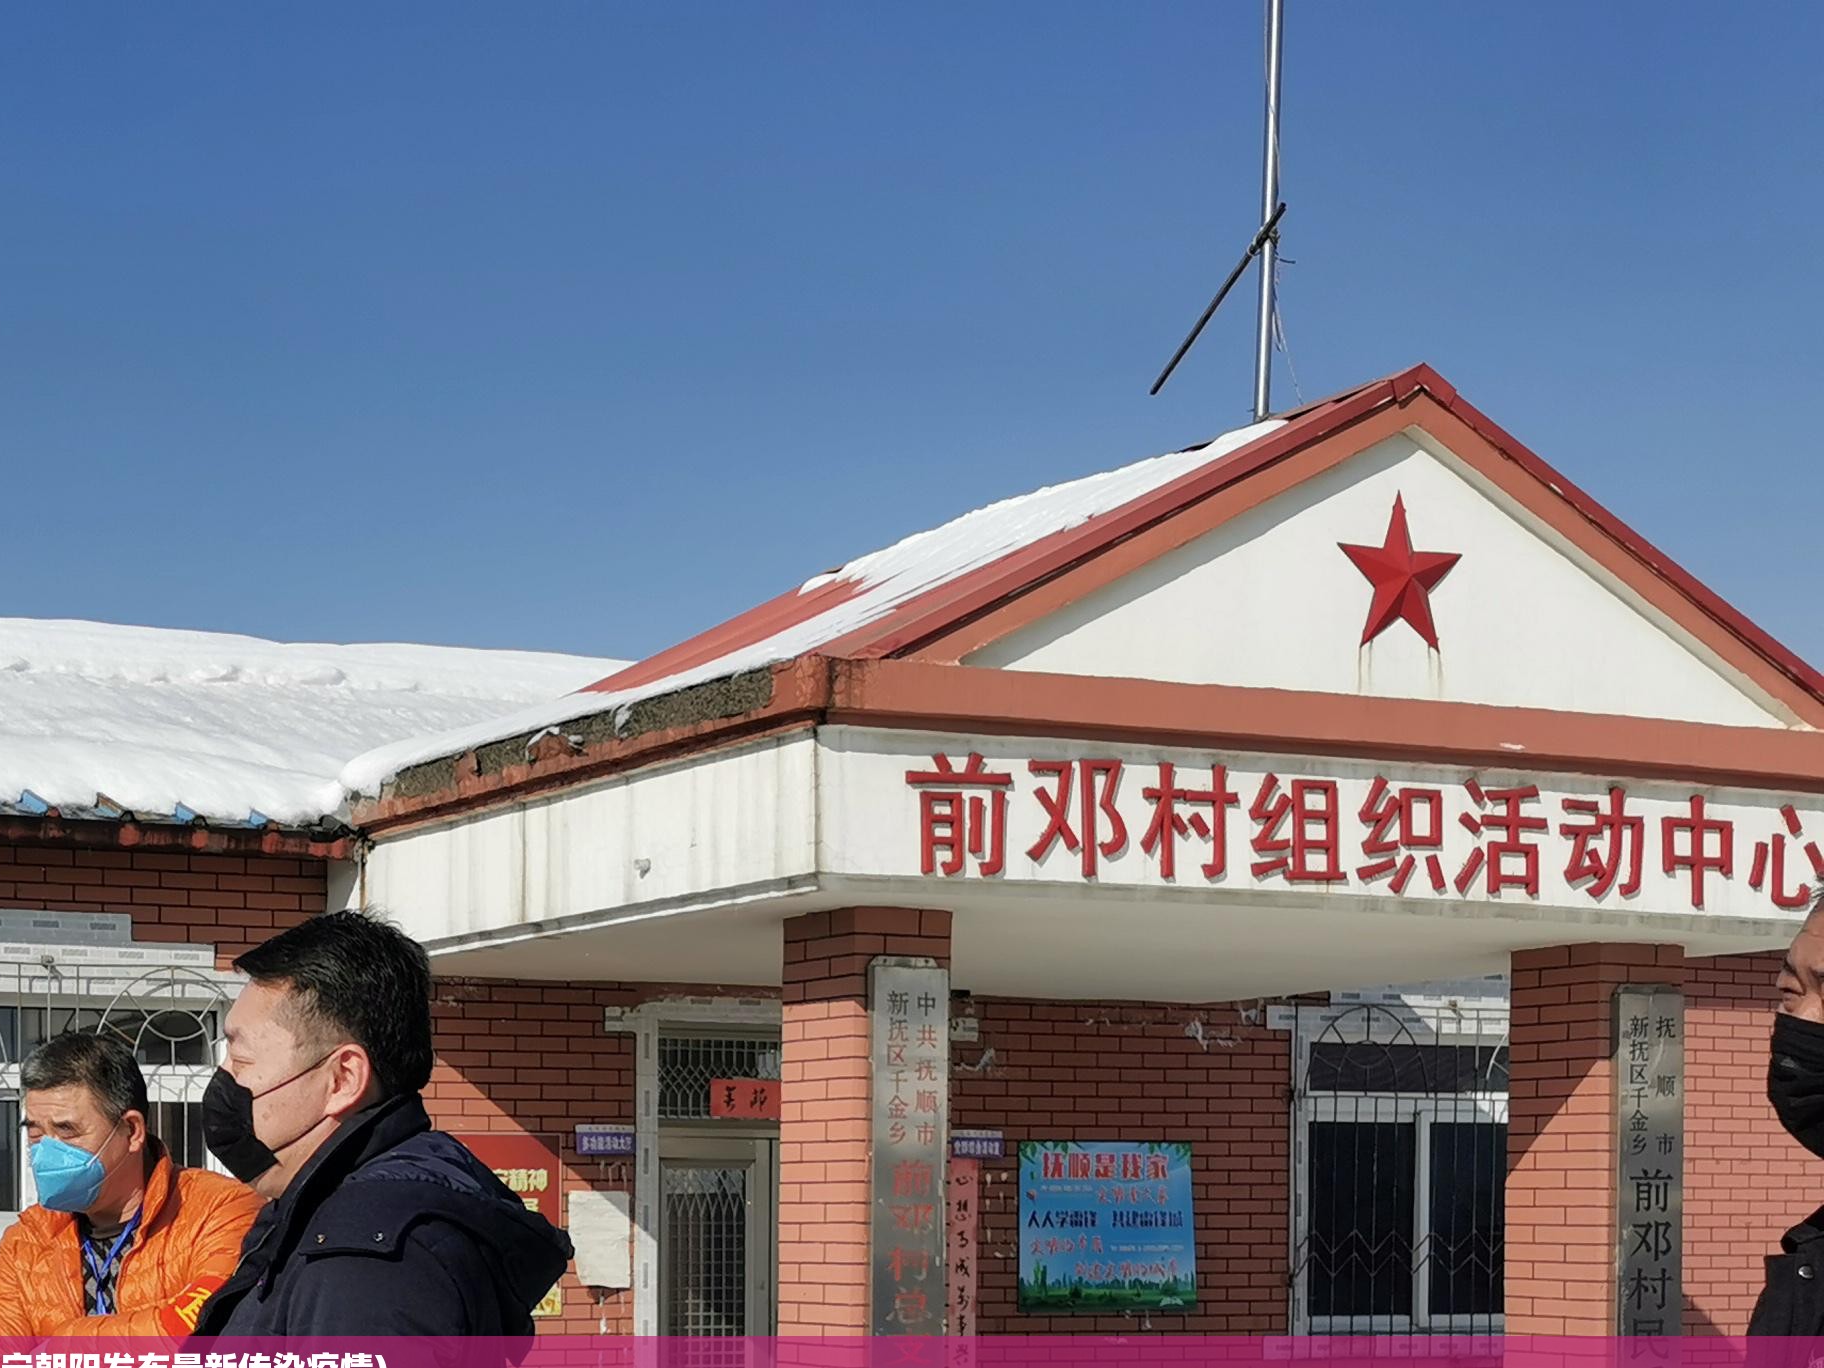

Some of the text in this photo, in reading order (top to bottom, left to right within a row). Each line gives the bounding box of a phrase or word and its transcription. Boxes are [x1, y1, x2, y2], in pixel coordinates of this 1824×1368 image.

[905, 750, 1824, 908] 前邓村组织活动中心
[886, 988, 909, 1146] 新抚区千金乡
[914, 991, 939, 1147] 中共抚顺市
[1629, 1015, 1650, 1157] 新抚区千金乡
[1655, 1015, 1677, 1157] 抚顺市
[1027, 1210, 1097, 1229] 人人学雷锋
[1042, 1152, 1169, 1181] 抚顺是我家
